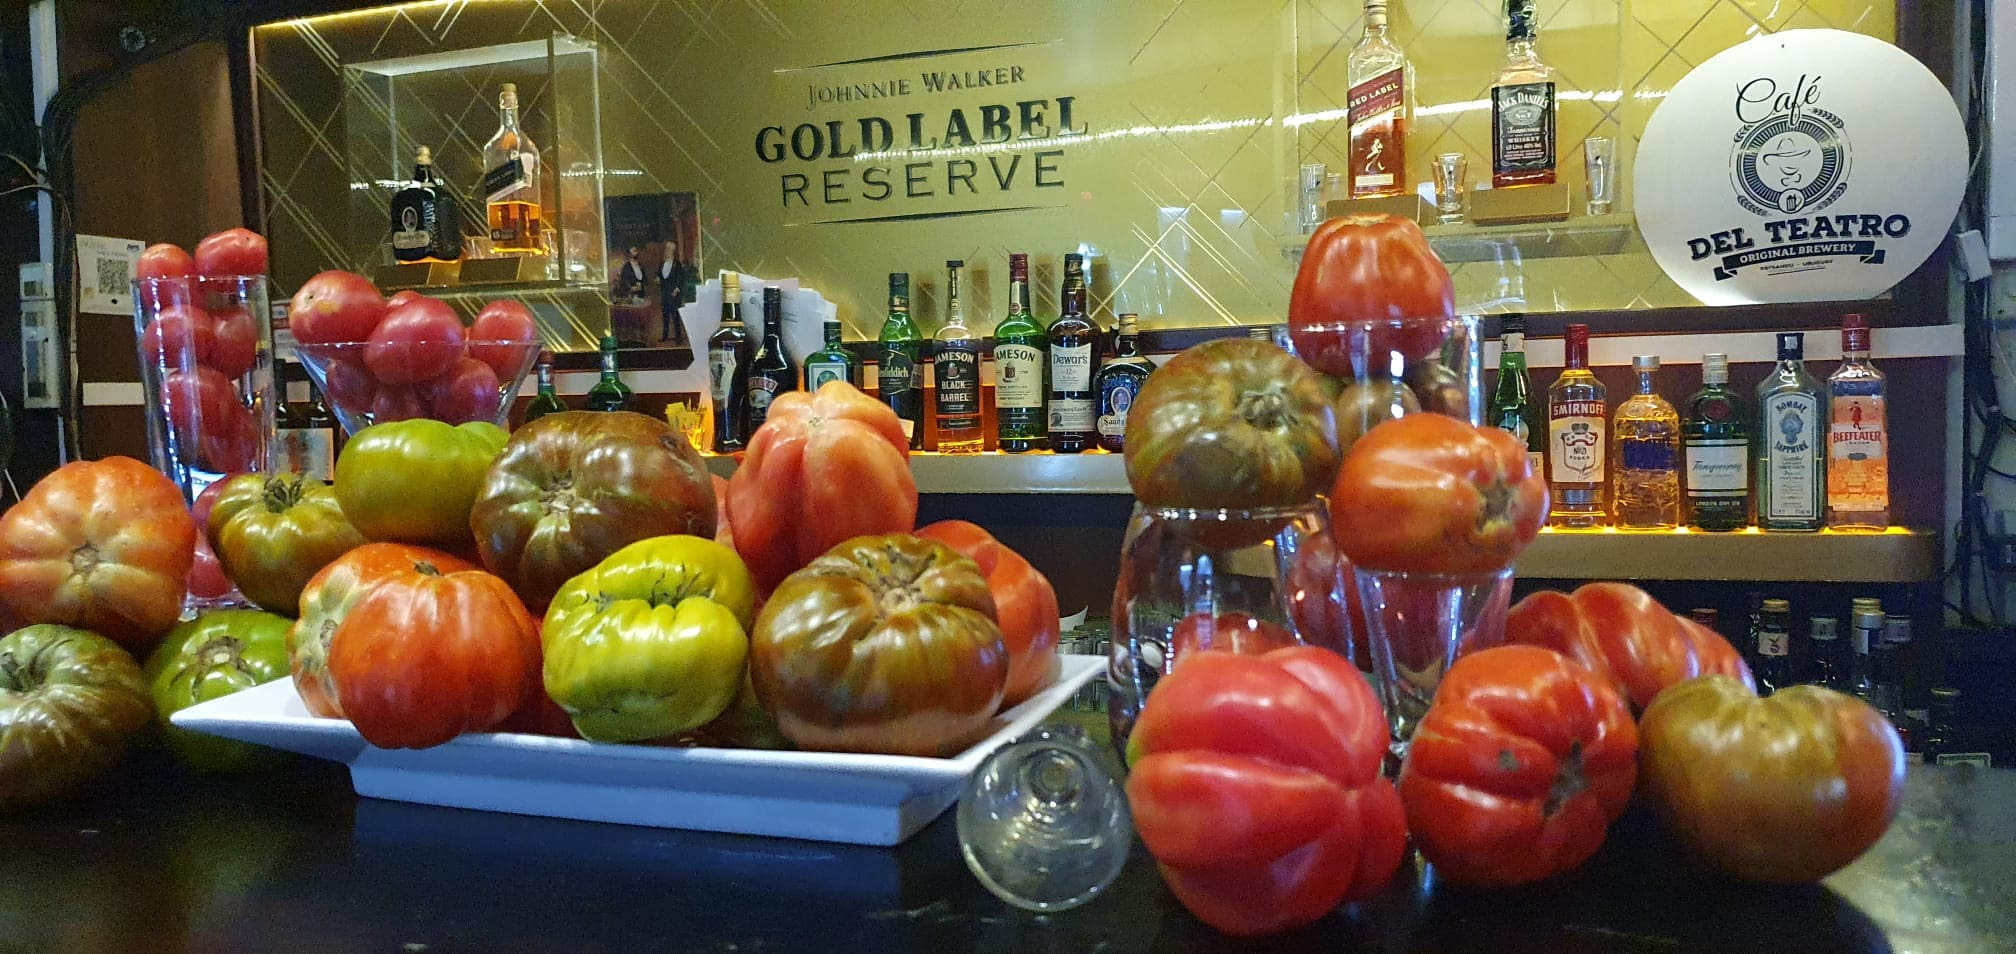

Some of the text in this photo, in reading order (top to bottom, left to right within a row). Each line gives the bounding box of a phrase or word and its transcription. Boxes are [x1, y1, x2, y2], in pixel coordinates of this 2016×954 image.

[807, 65, 1025, 110] JOHNNIE WALKER
[1350, 82, 1400, 108] RED LABEL
[1498, 95, 1518, 113] JACK
[1735, 74, 1823, 125] Café
[755, 96, 1089, 163] GOLD LABEL
[1507, 136, 1541, 144] WHISKEY
[781, 150, 1065, 207] RESERVE
[1687, 213, 1912, 262] DEL TEATRO
[1739, 242, 1857, 264] ORIGINAL BREWERY
[935, 351, 975, 365] JAMESON
[1053, 353, 1088, 365] Dewar's
[941, 380, 966, 390] BLACK
[940, 393, 969, 402] BARREL
[1776, 400, 1808, 414] BOMBAY
[1833, 431, 1882, 443] BEEFEATER
[1774, 440, 1809, 454] SAPPHIRE
